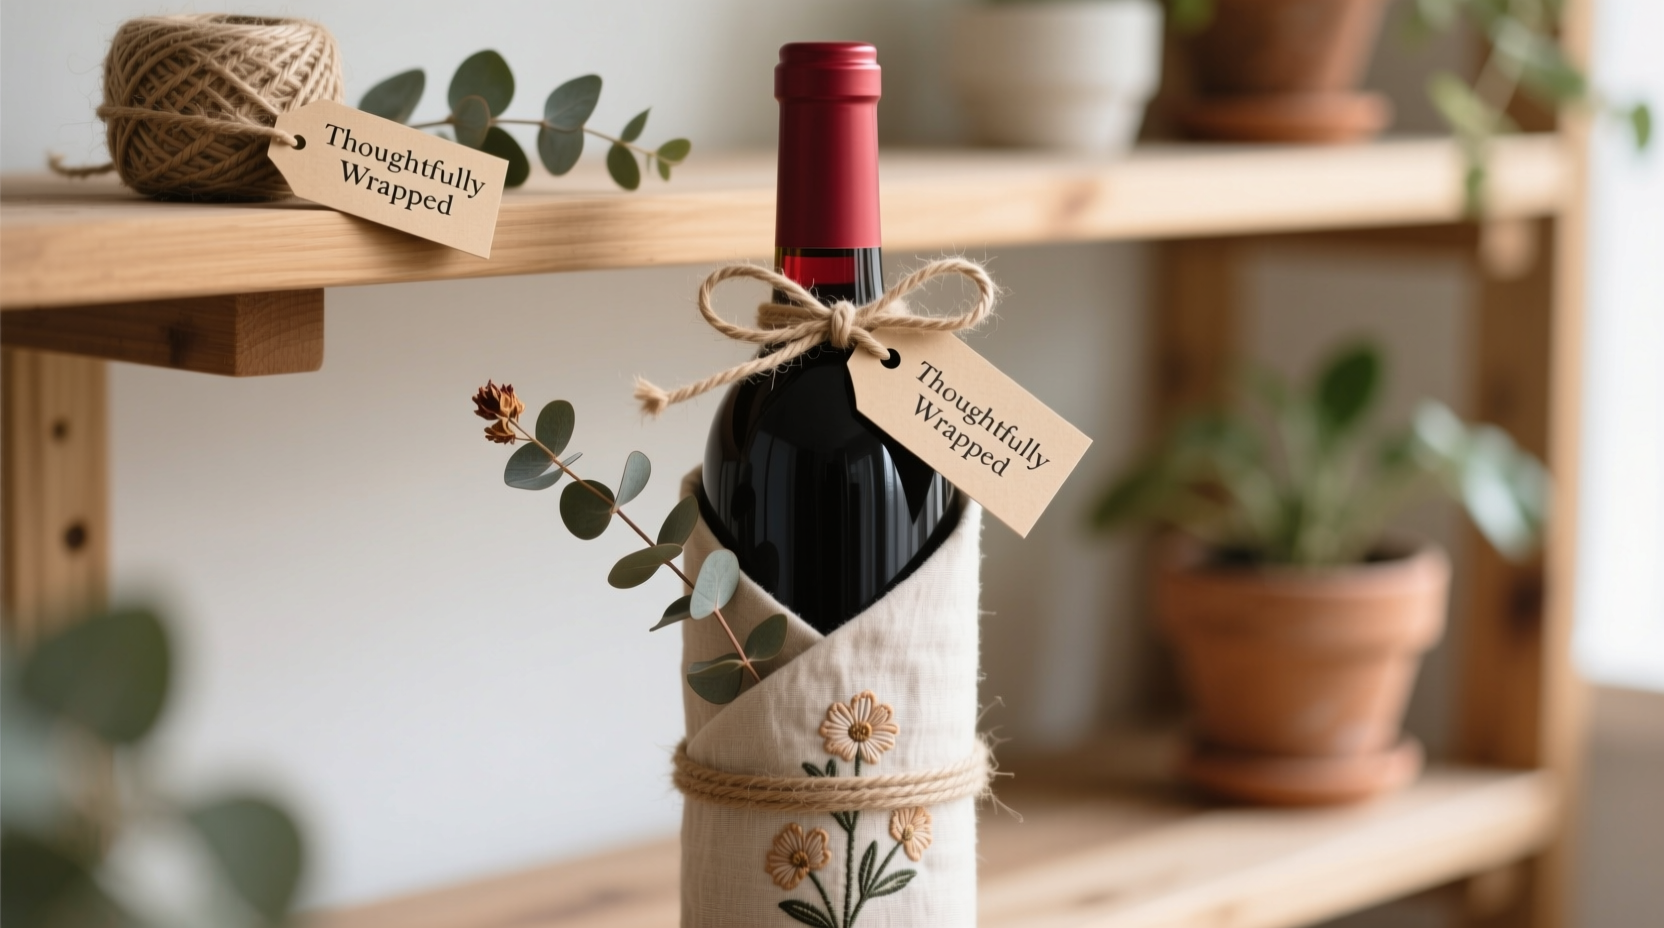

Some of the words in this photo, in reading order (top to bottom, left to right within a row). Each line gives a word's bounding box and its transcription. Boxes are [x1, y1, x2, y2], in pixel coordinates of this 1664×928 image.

[325, 123, 486, 199] Thoughtfully
[341, 159, 454, 216] Wrapped
[914, 394, 1011, 477] Wrapped
[916, 360, 1050, 471] Thoughtfully
